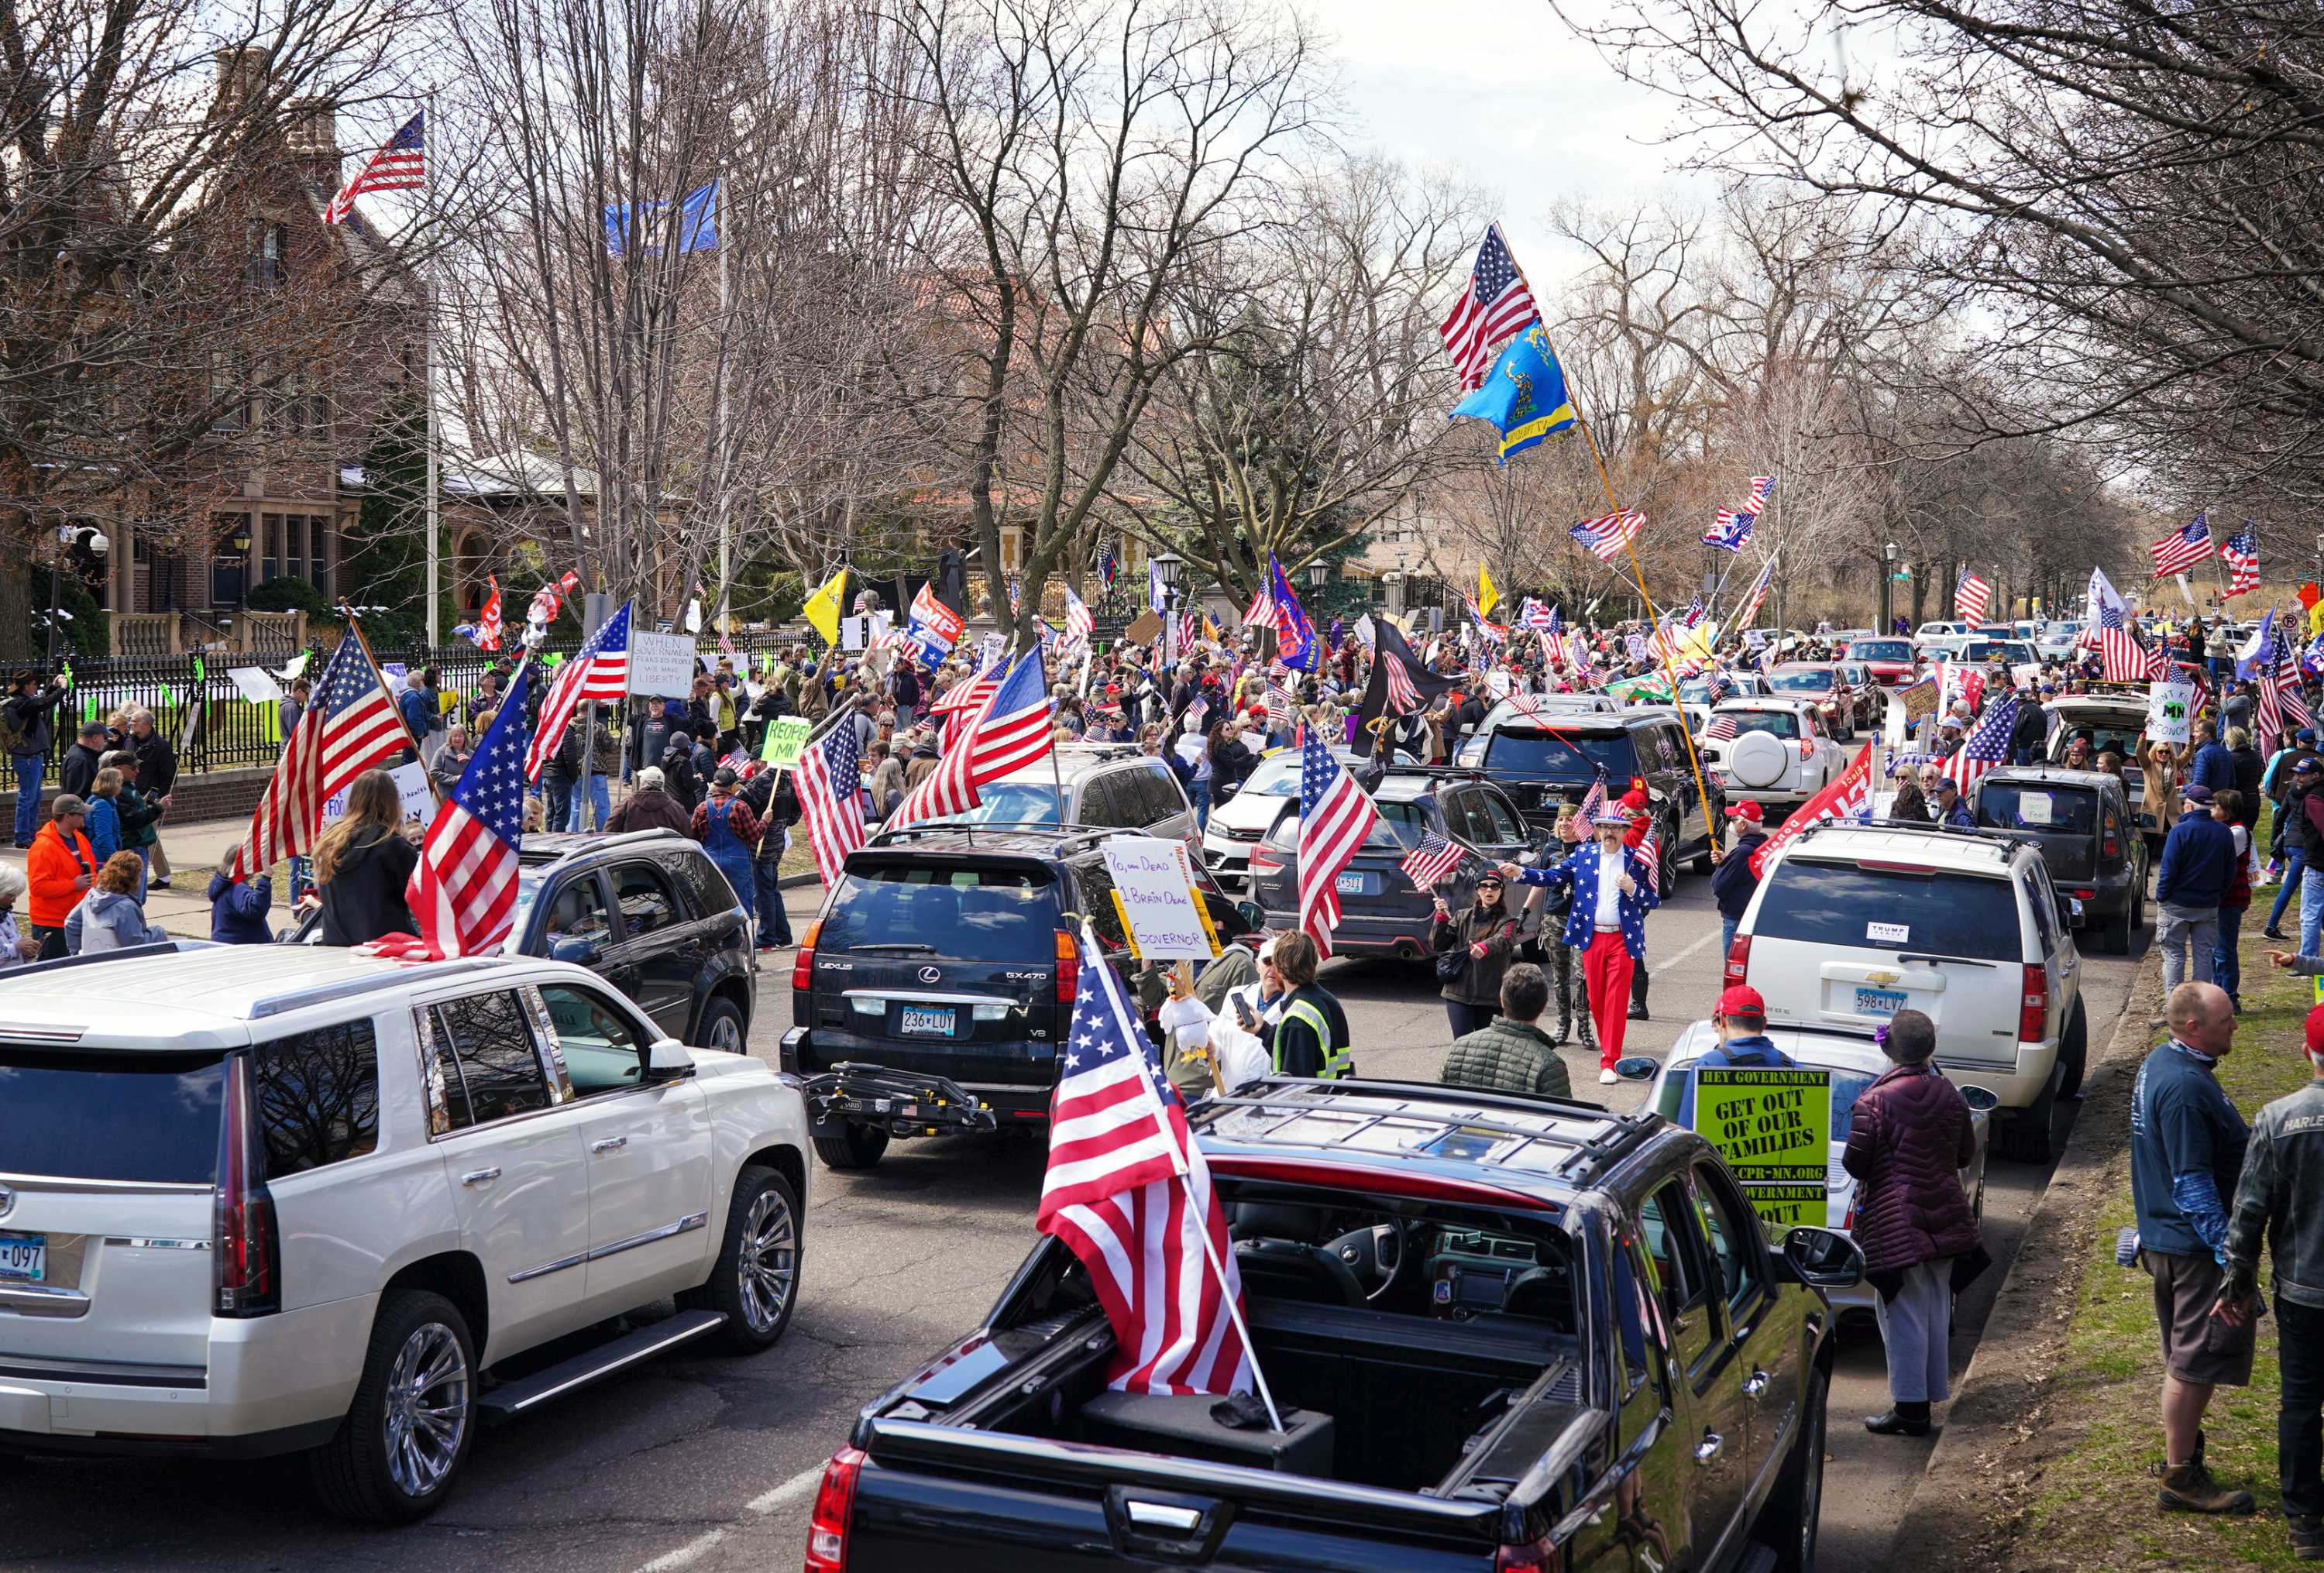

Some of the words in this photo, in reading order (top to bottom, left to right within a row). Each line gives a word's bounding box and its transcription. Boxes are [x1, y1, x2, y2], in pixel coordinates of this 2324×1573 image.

[644, 636, 681, 649] WHEN
[633, 645, 694, 658] GOVERNMENT
[636, 655, 658, 664] FEARS
[2162, 706, 2185, 720] MN
[775, 743, 798, 759] MN
[1346, 878, 1360, 888] 511
[1131, 887, 1162, 905] BRAIN
[1133, 922, 1203, 946] GOVERNOR
[819, 962, 853, 970] LEXUS
[1857, 994, 1877, 1008] 598
[904, 1012, 924, 1027] 236
[933, 1014, 954, 1029] LUY
[1703, 1070, 1731, 1084] HEY
[1735, 1071, 1826, 1084] GOVERNMENT
[1715, 1097, 1756, 1121] GET
[1762, 1088, 1806, 1112] OUT
[1723, 1118, 1751, 1139] OF
[1756, 1110, 1803, 1133] OUR
[12, 1245, 40, 1270] 097
